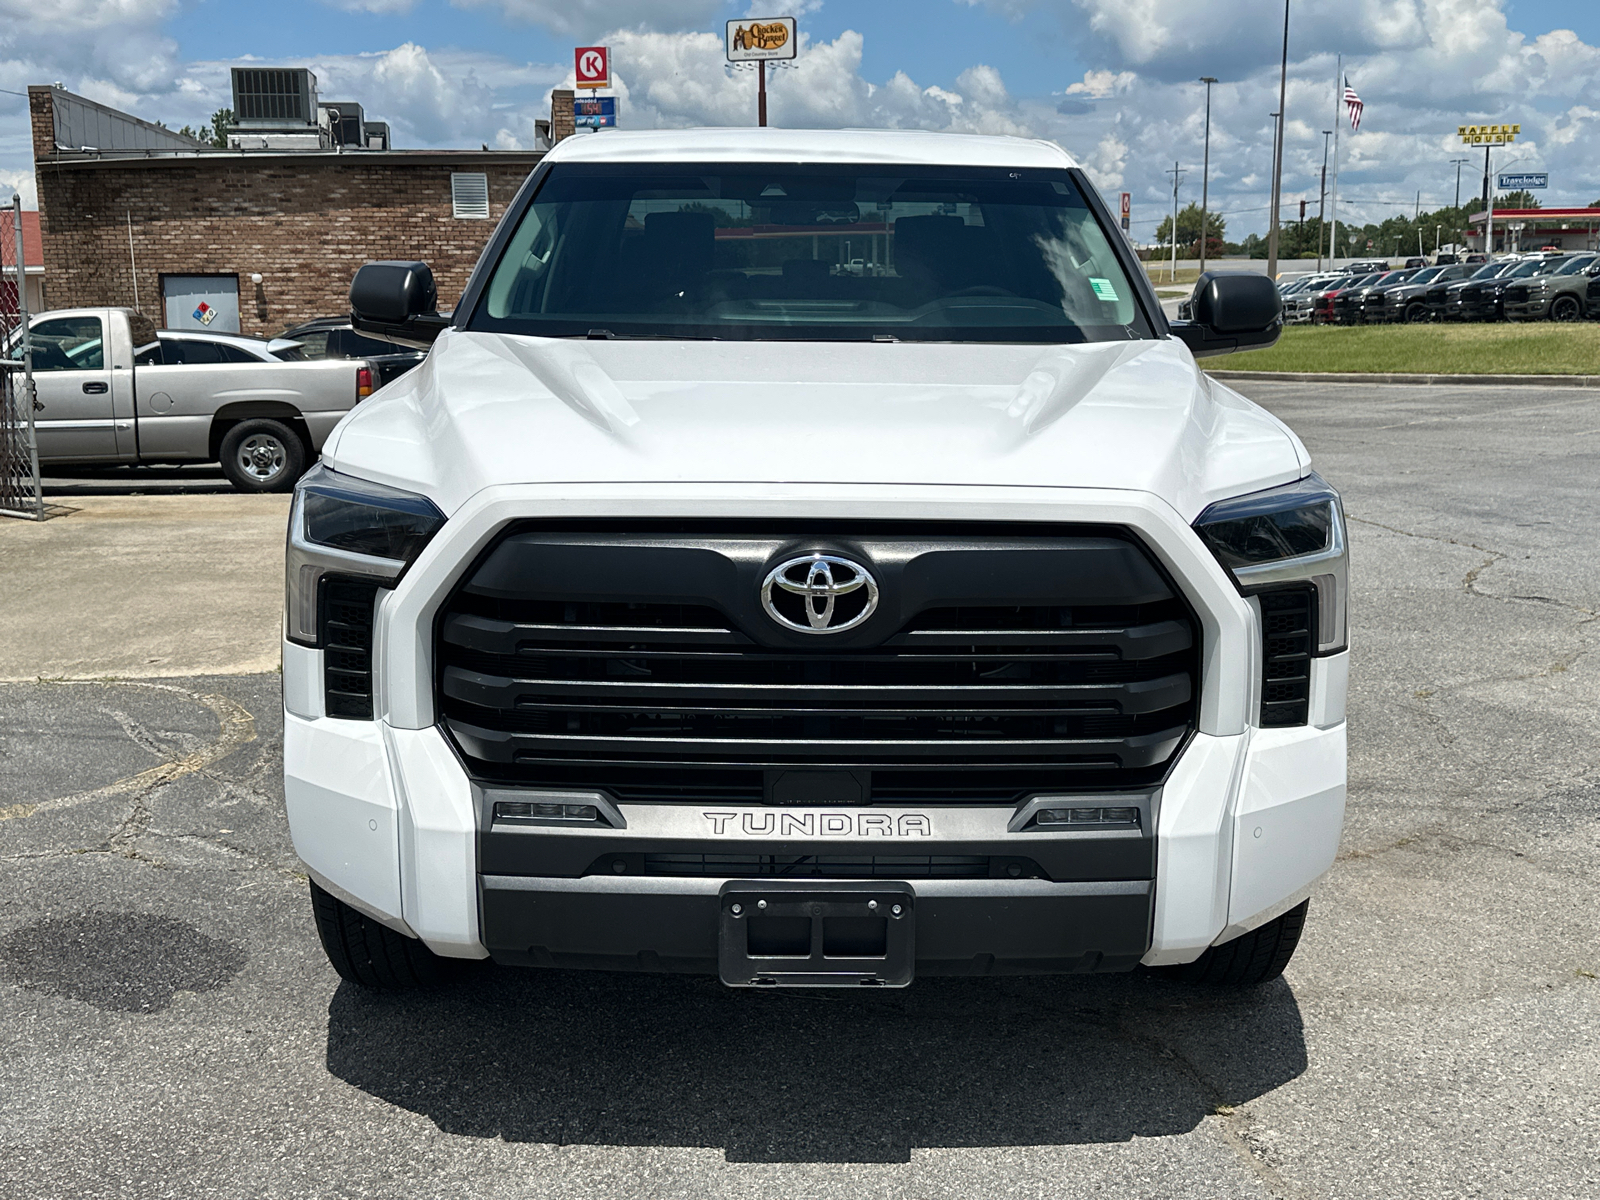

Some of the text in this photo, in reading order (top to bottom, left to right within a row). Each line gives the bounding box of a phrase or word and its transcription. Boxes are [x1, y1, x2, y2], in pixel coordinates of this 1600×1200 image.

[757, 33, 785, 48] Barrel
[586, 57, 601, 74] K
[1458, 125, 1519, 135] WAFFLE
[1463, 134, 1514, 143] HOUSE
[1502, 176, 1545, 185] Travelodge
[703, 812, 931, 837] TUNDRA
